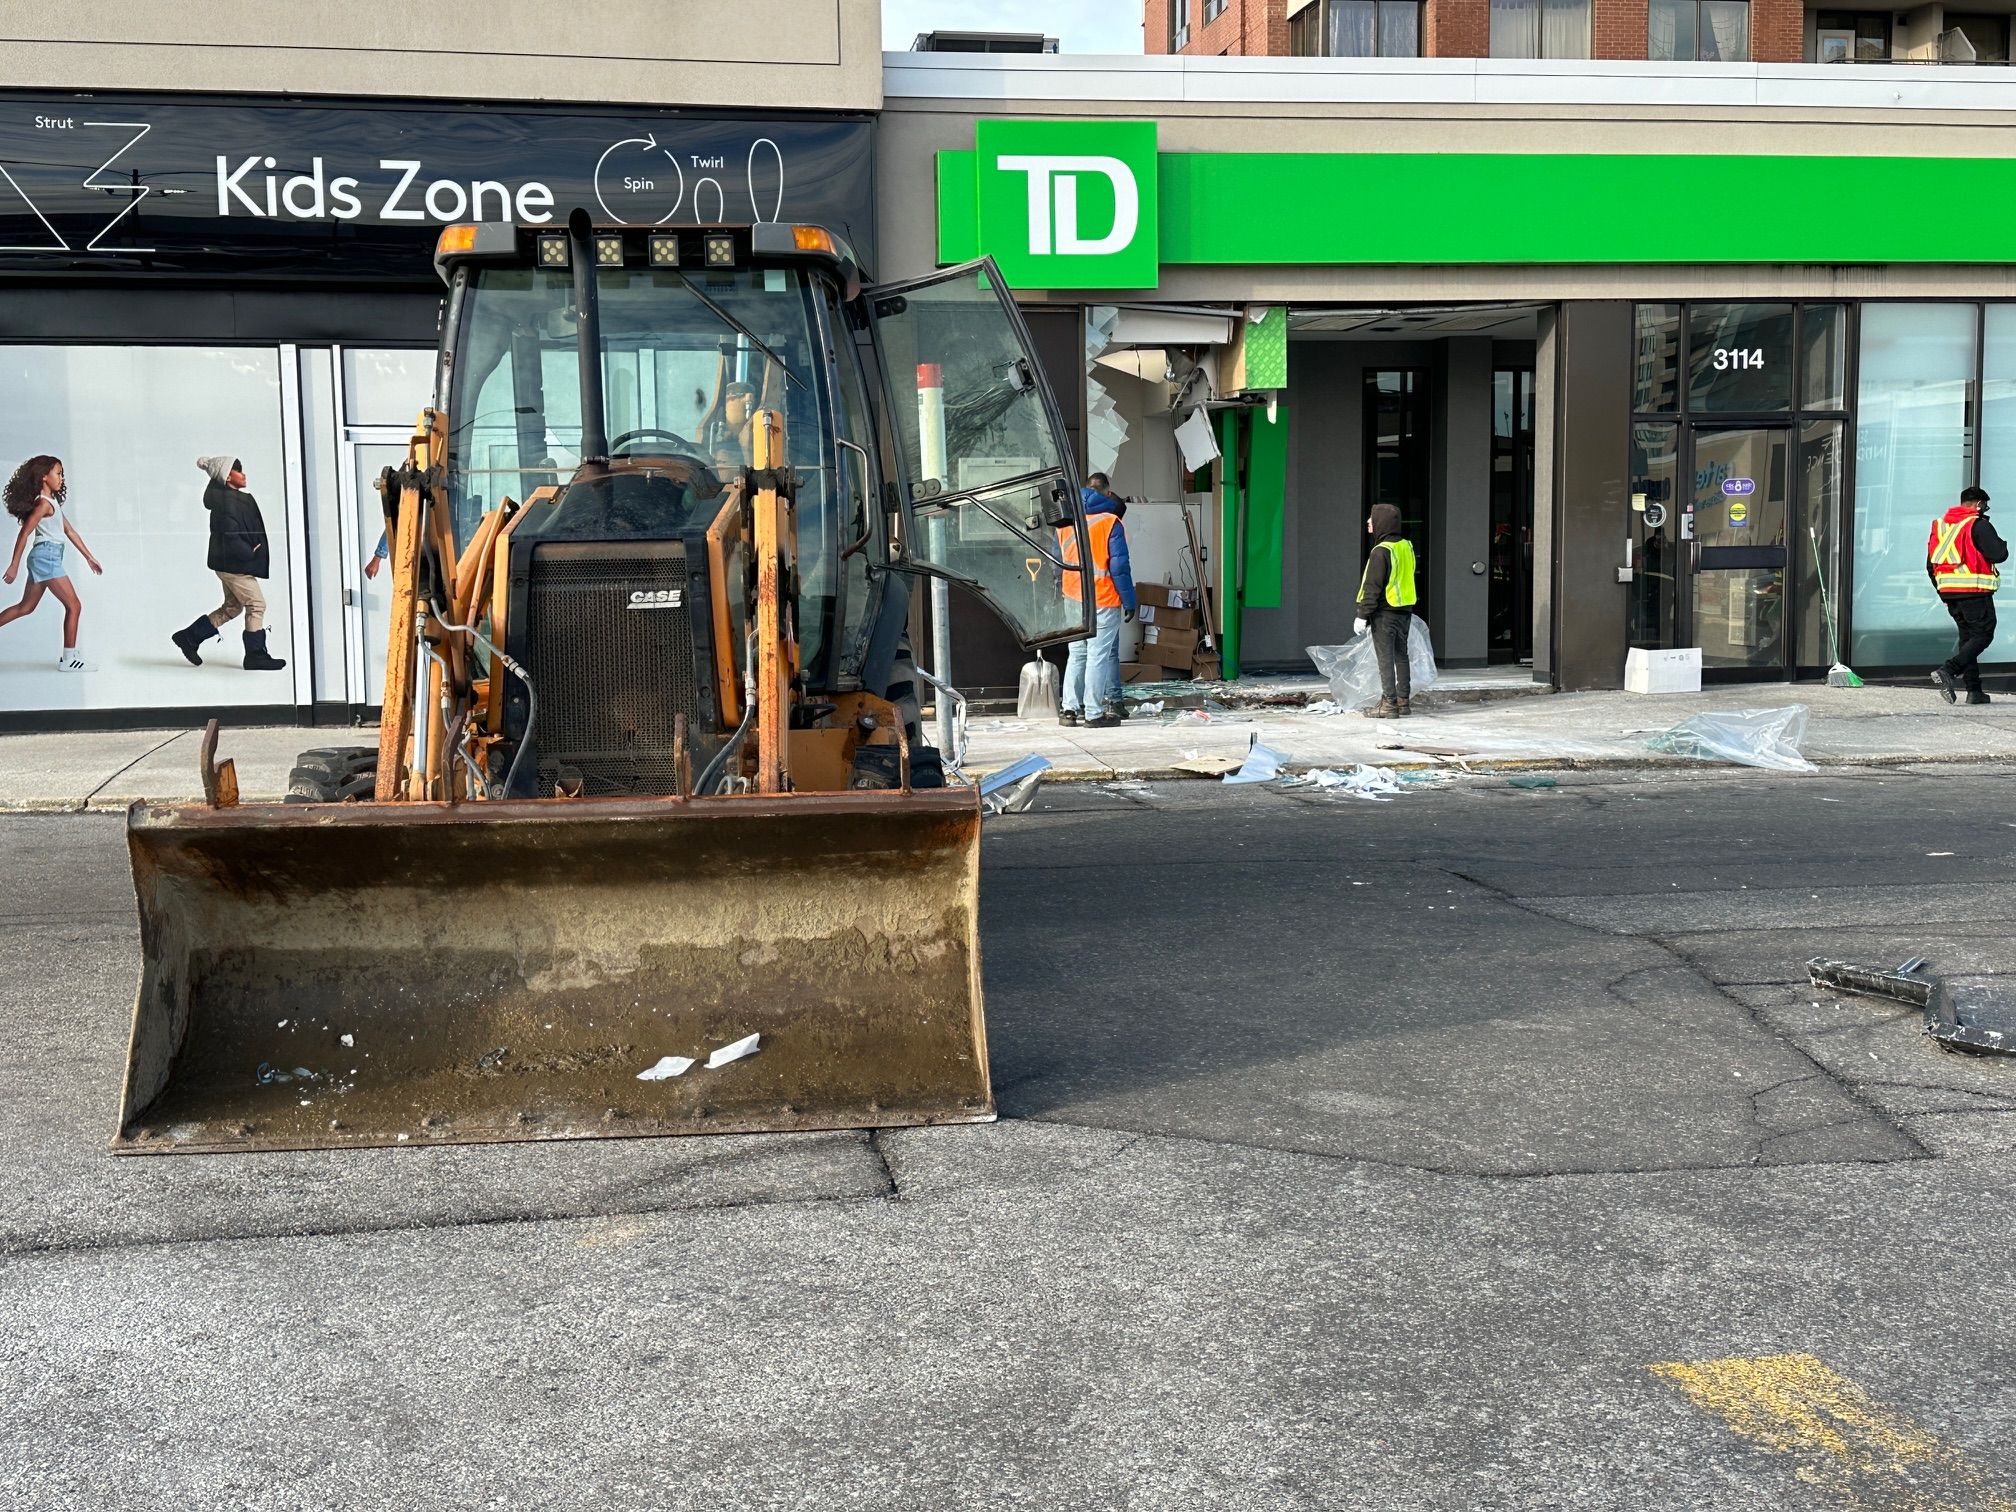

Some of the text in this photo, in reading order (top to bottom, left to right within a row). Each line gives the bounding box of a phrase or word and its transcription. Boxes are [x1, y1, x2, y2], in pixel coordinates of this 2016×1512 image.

[35, 115, 74, 129] Strut
[690, 155, 724, 168] Twirl
[216, 155, 555, 223] Kids Zone
[624, 176, 654, 193] Spin
[997, 155, 1139, 255] TD
[1712, 348, 1765, 370] 3114
[630, 589, 682, 603] CASE
